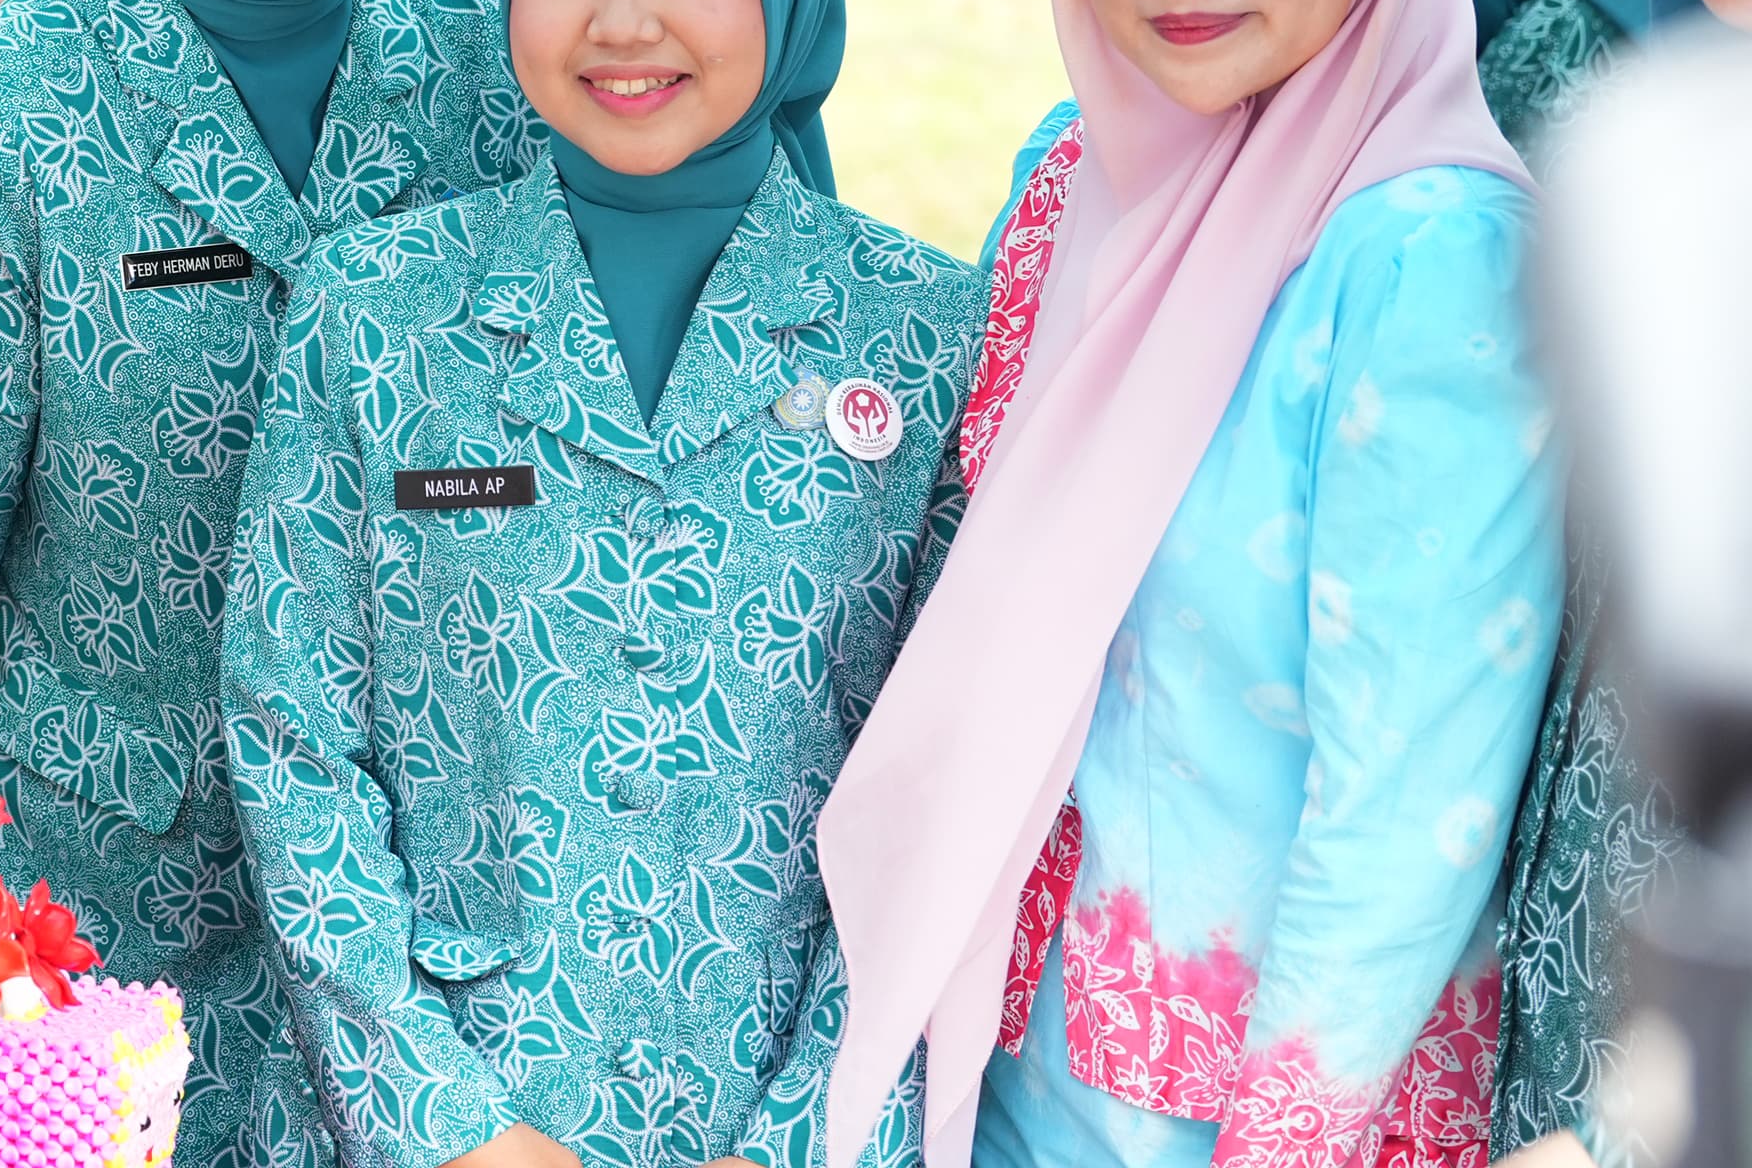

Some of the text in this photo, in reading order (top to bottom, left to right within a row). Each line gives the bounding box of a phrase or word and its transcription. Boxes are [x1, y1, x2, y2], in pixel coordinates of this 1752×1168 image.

[131, 253, 244, 278] FEBY HERMAN DERU
[852, 434, 887, 444] INDONESIA
[425, 477, 505, 498] NABILA AP
